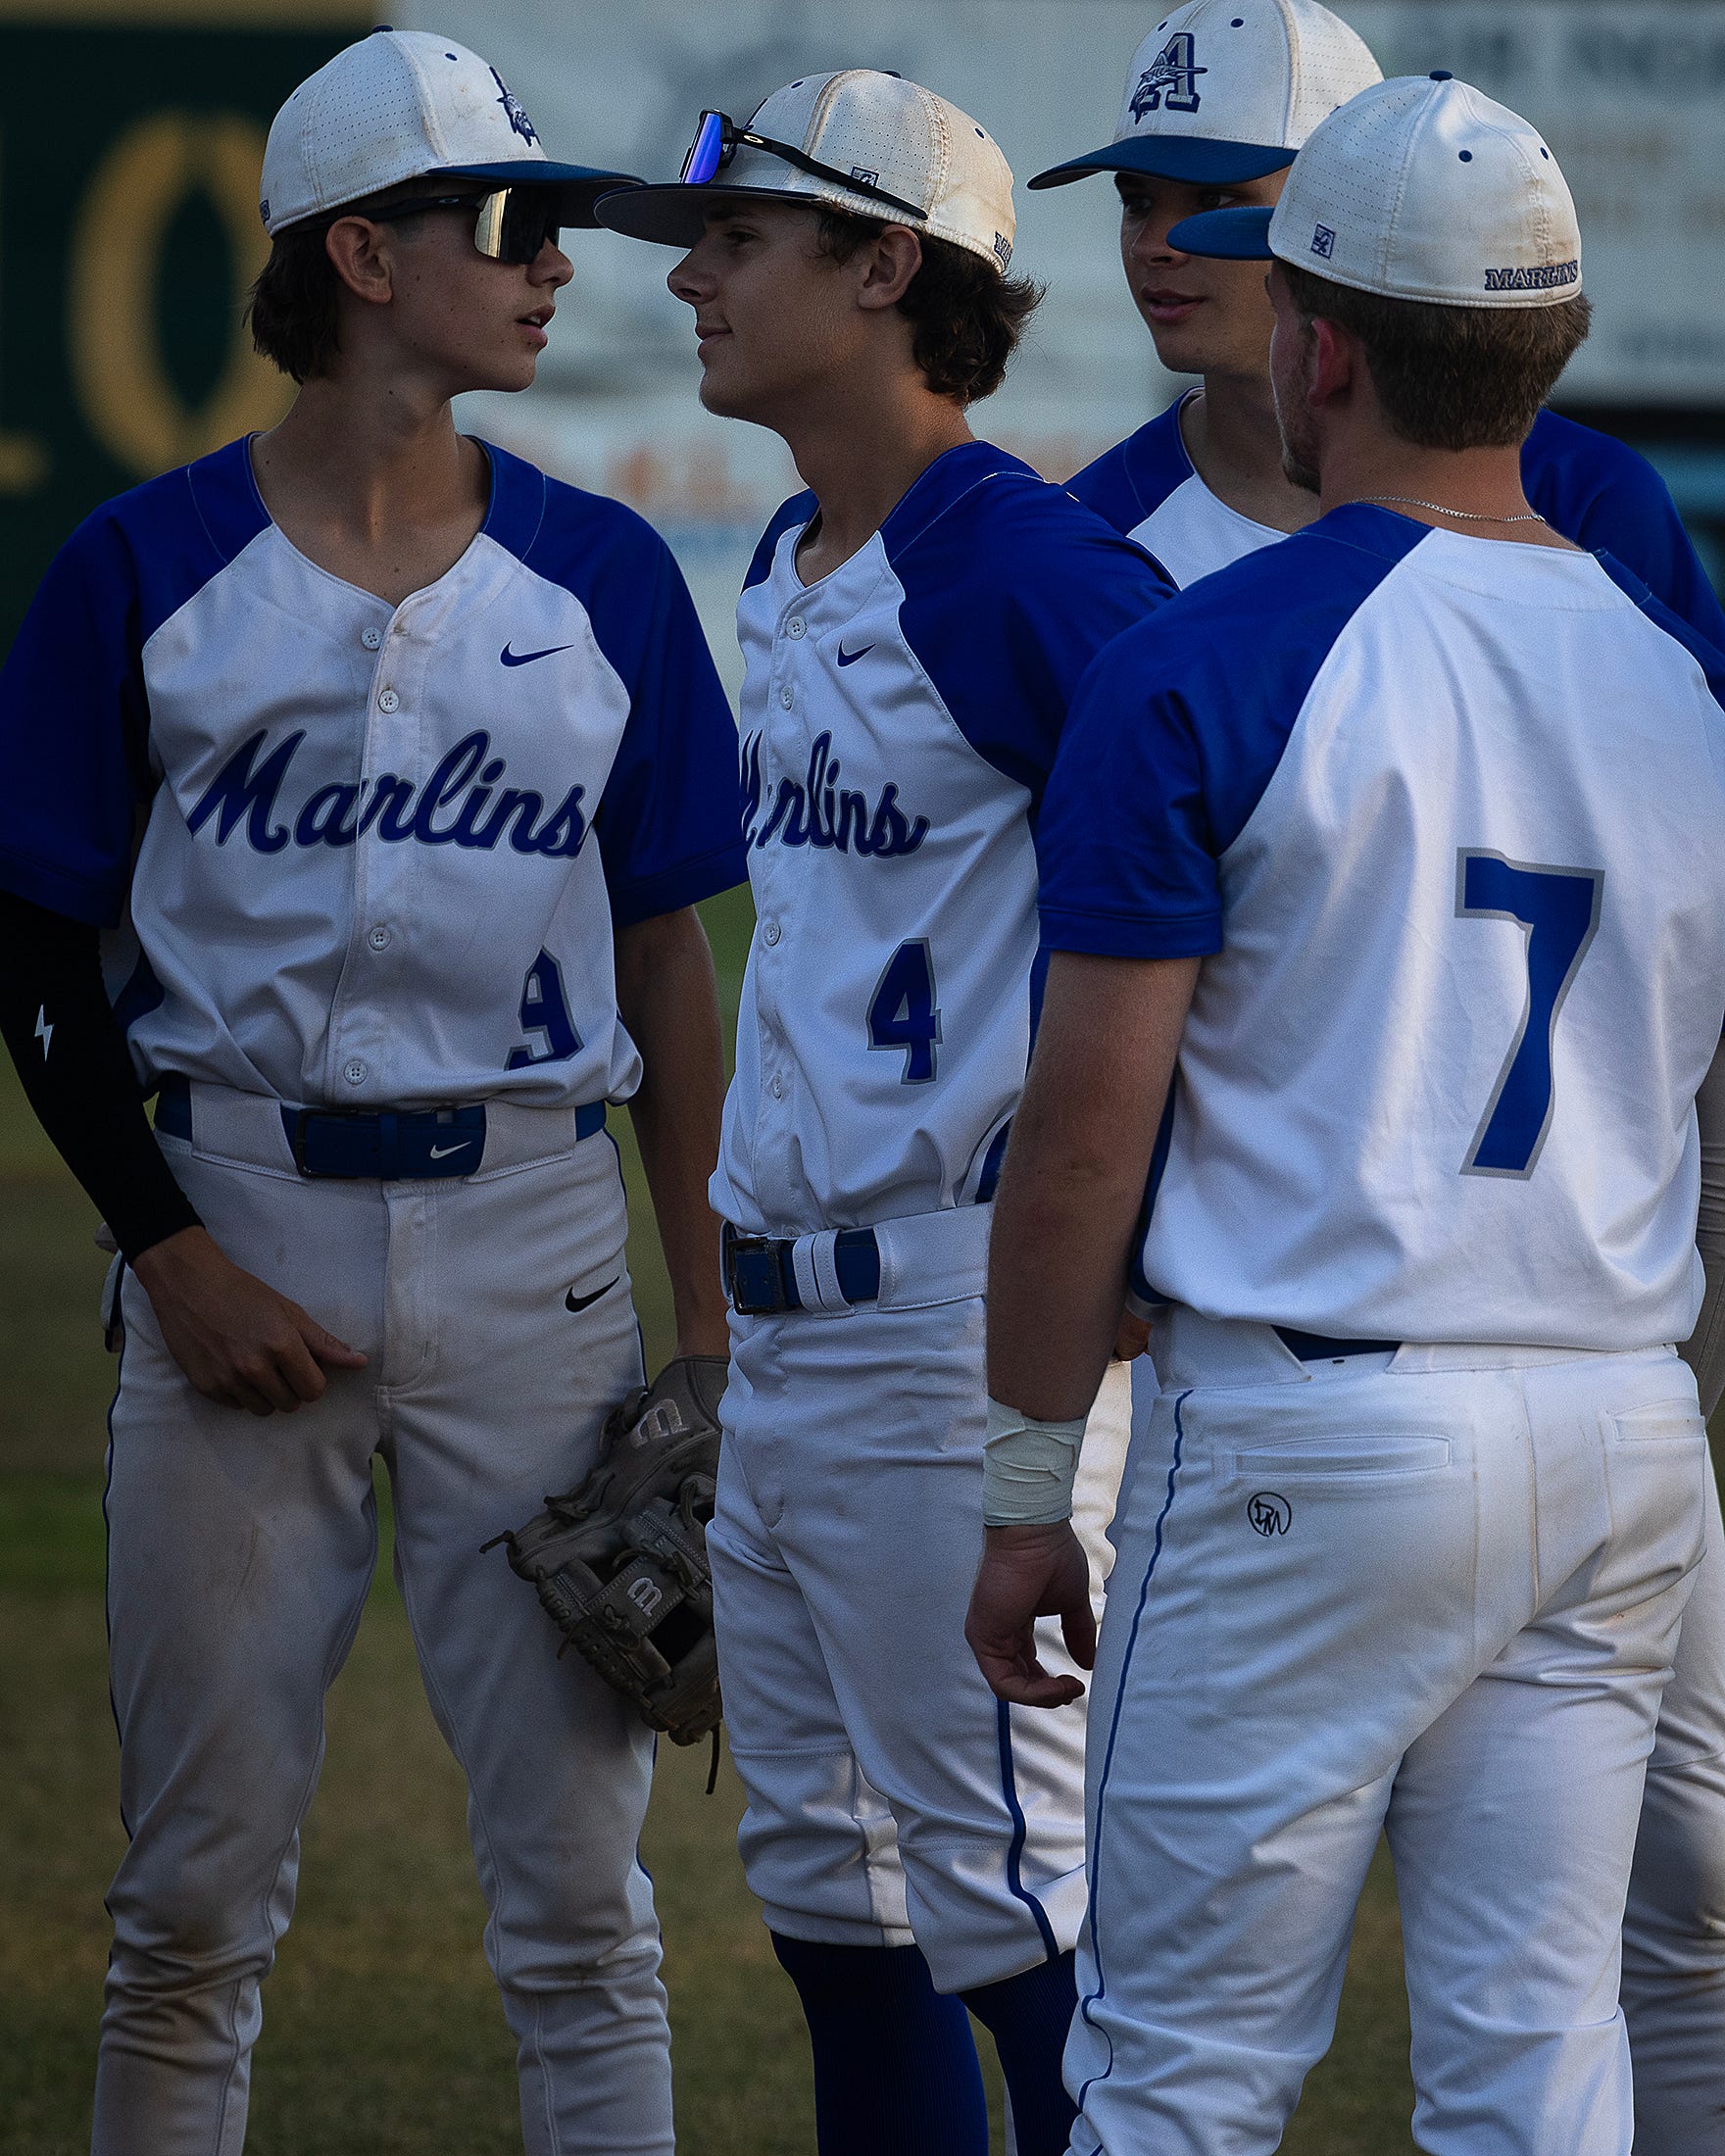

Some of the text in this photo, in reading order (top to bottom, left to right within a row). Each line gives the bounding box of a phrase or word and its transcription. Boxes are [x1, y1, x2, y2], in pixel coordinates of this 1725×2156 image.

[1484, 260, 1578, 291] MARLINS
[186, 728, 595, 859] Marlins
[739, 729, 931, 859] Mrlins
[504, 945, 586, 1072] 9
[866, 937, 943, 1086] 4
[1454, 847, 1605, 1181] 7
